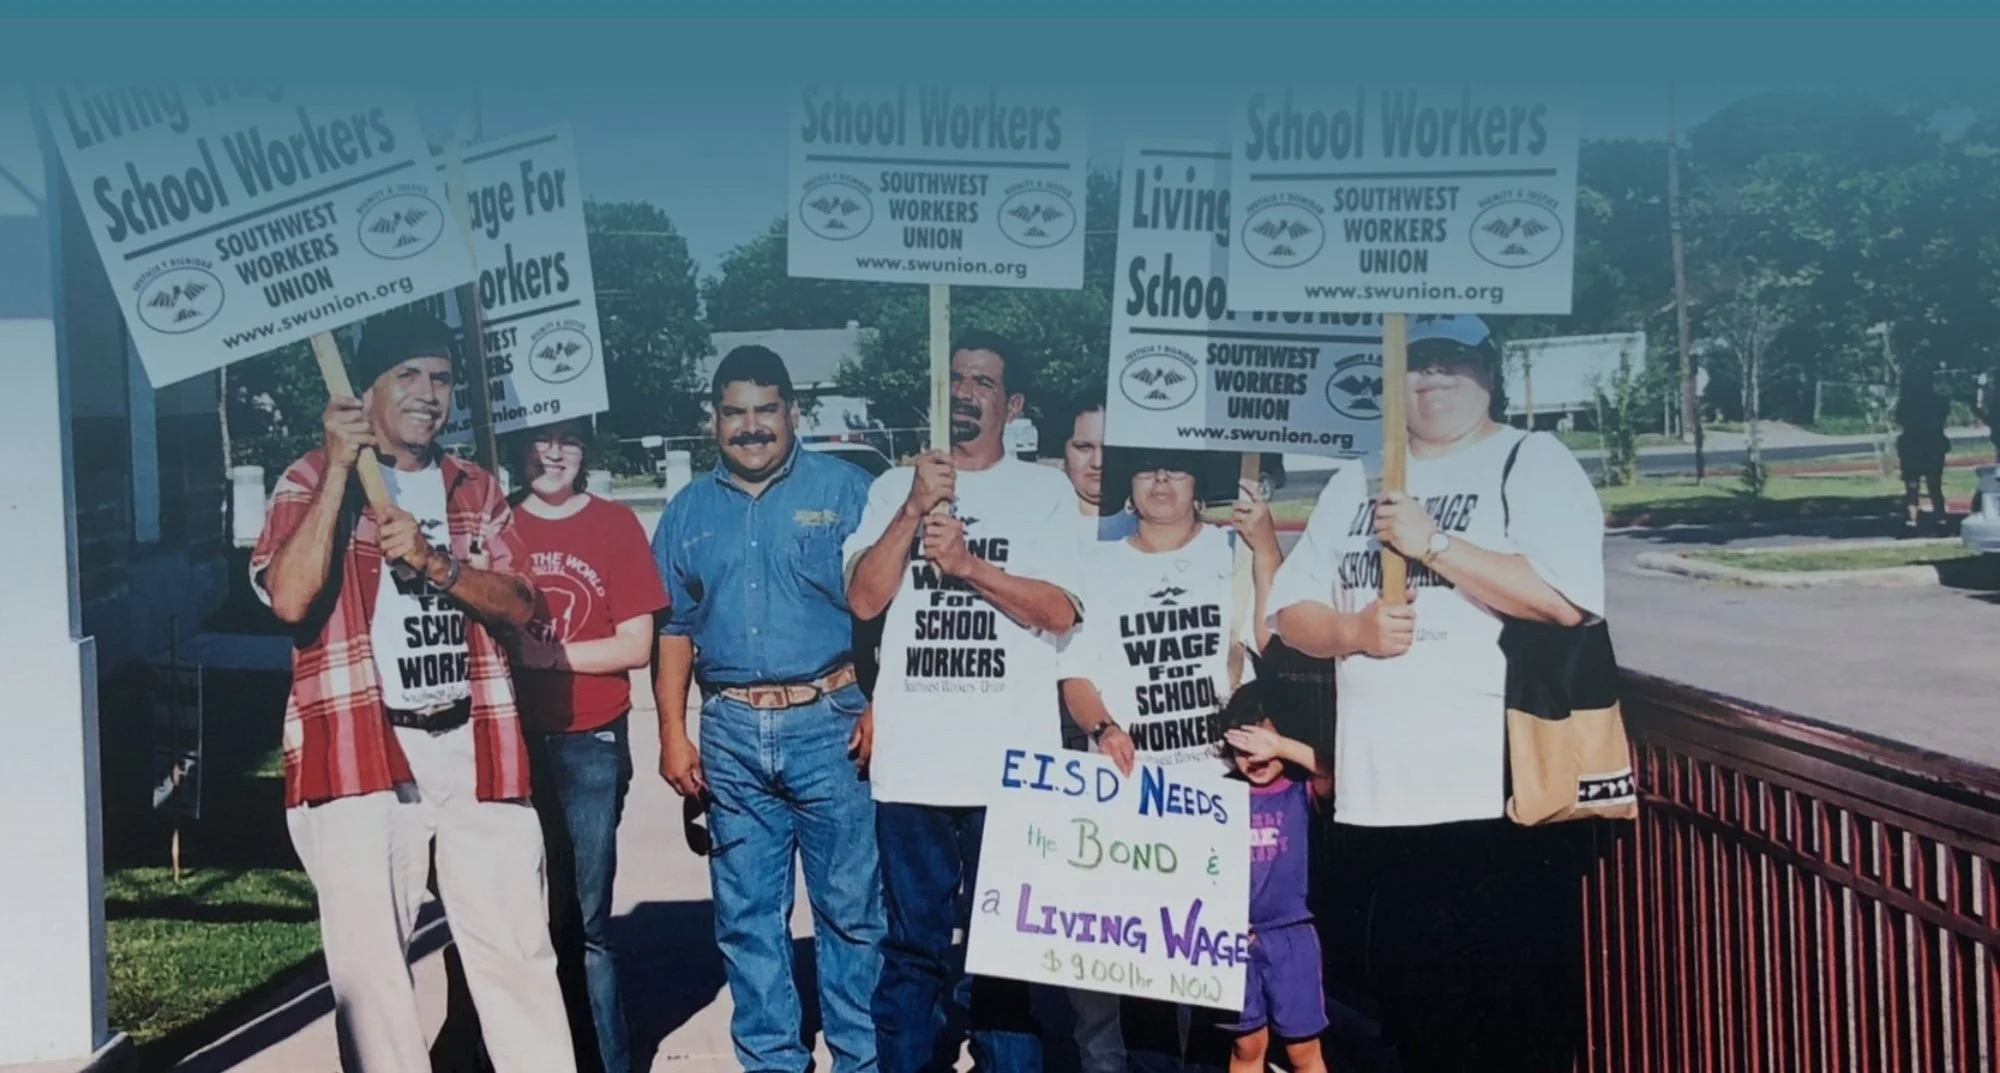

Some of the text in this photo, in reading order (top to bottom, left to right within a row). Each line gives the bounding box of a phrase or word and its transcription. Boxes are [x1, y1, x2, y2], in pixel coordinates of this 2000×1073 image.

[801, 81, 1062, 151] School Workers
[1245, 81, 1548, 161] School Workers
[93, 106, 396, 243] School Workers
[879, 170, 990, 197] SOUTHWEST
[466, 158, 568, 240] age For
[888, 198, 980, 224] WORKERS
[1132, 164, 1231, 248] Living
[1332, 186, 1461, 213] SOUTHWEST
[214, 201, 338, 262] SOUTHWEST
[902, 225, 964, 251] UNION
[1343, 217, 1448, 243] WORKERS
[234, 233, 340, 286] WORKERS
[479, 242, 570, 310] orkers
[856, 255, 1028, 279] www.swunion.org
[1359, 248, 1429, 275] UNION
[262, 265, 335, 309] UNION
[1126, 252, 1236, 321] Schoo
[1304, 282, 1504, 304] www.swunion.org
[220, 275, 415, 351] www.swunion.org
[1206, 343, 1320, 370] SOUTHWEST
[1214, 369, 1308, 396] WORKERS
[1227, 396, 1290, 421] UNION
[1177, 425, 1354, 449] www.swunion.org
[910, 536, 1009, 562] LNG
[530, 552, 606, 598] THE WORLD
[404, 613, 464, 648] SCHO
[915, 610, 998, 641] SCHOOL
[1119, 604, 1221, 638] LIVING
[906, 646, 1006, 678] WORKERS
[1123, 633, 1220, 666] WAGE
[398, 652, 470, 689] WORK
[1149, 663, 1202, 681] For
[1135, 676, 1217, 716] SCHOOL
[1129, 711, 1222, 752] WORKER
[1027, 824, 1057, 858] the
[981, 888, 1002, 916] a
[1169, 972, 1223, 1003] NOW
